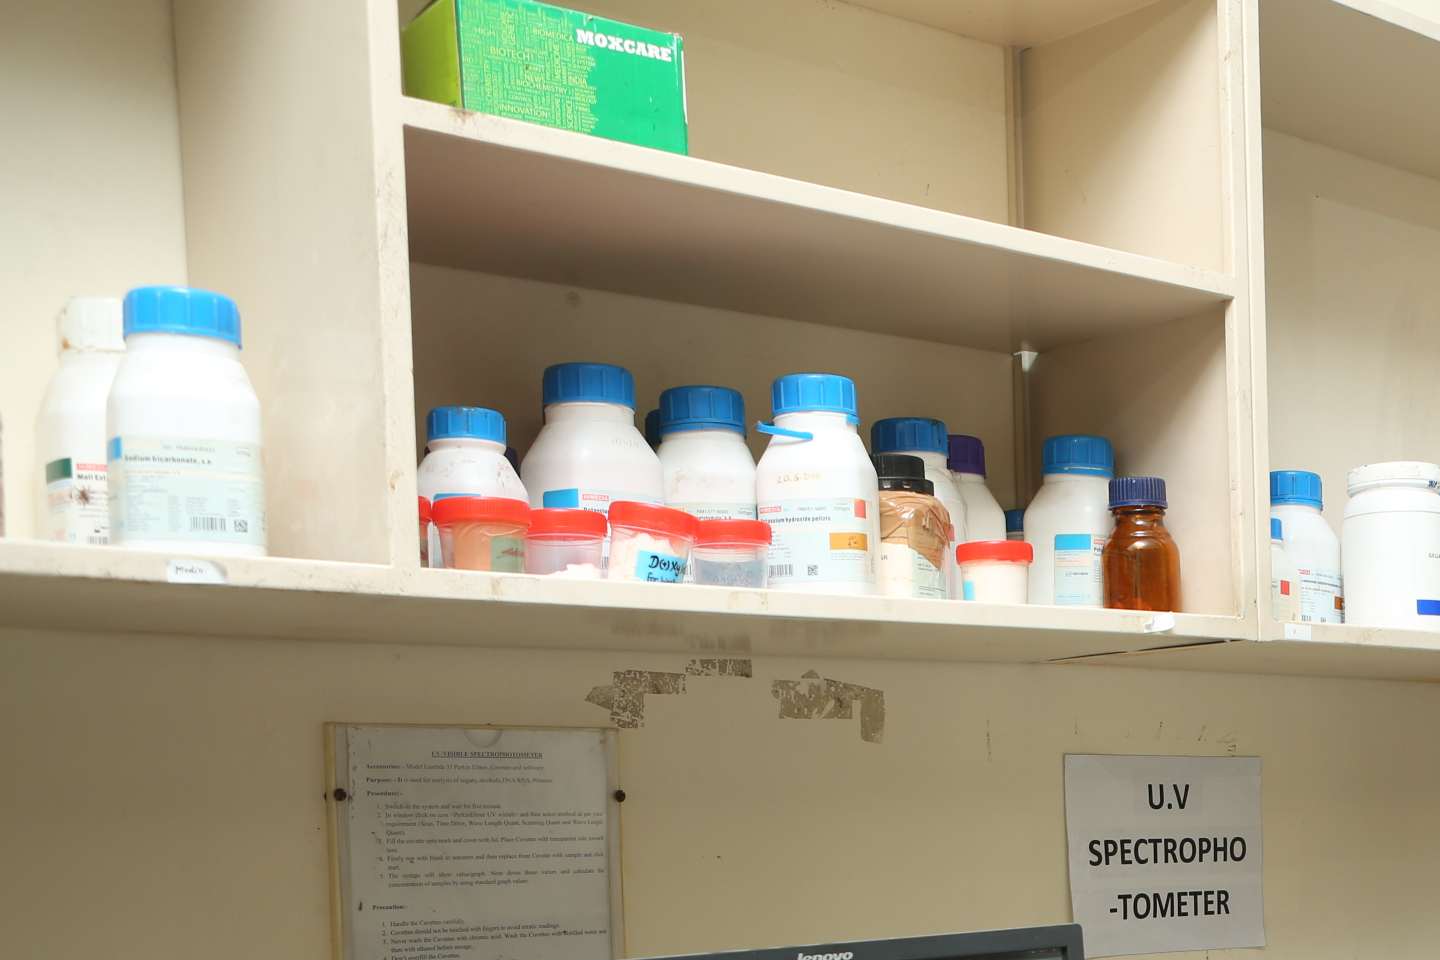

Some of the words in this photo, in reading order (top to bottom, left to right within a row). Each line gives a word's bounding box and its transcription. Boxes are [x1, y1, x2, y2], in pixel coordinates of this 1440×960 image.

[576, 28, 672, 63] MOXCARE
[1147, 784, 1190, 810] U.V
[1088, 836, 1247, 866] SPECTROPHO
[1109, 889, 1231, 920] -TOMETER
